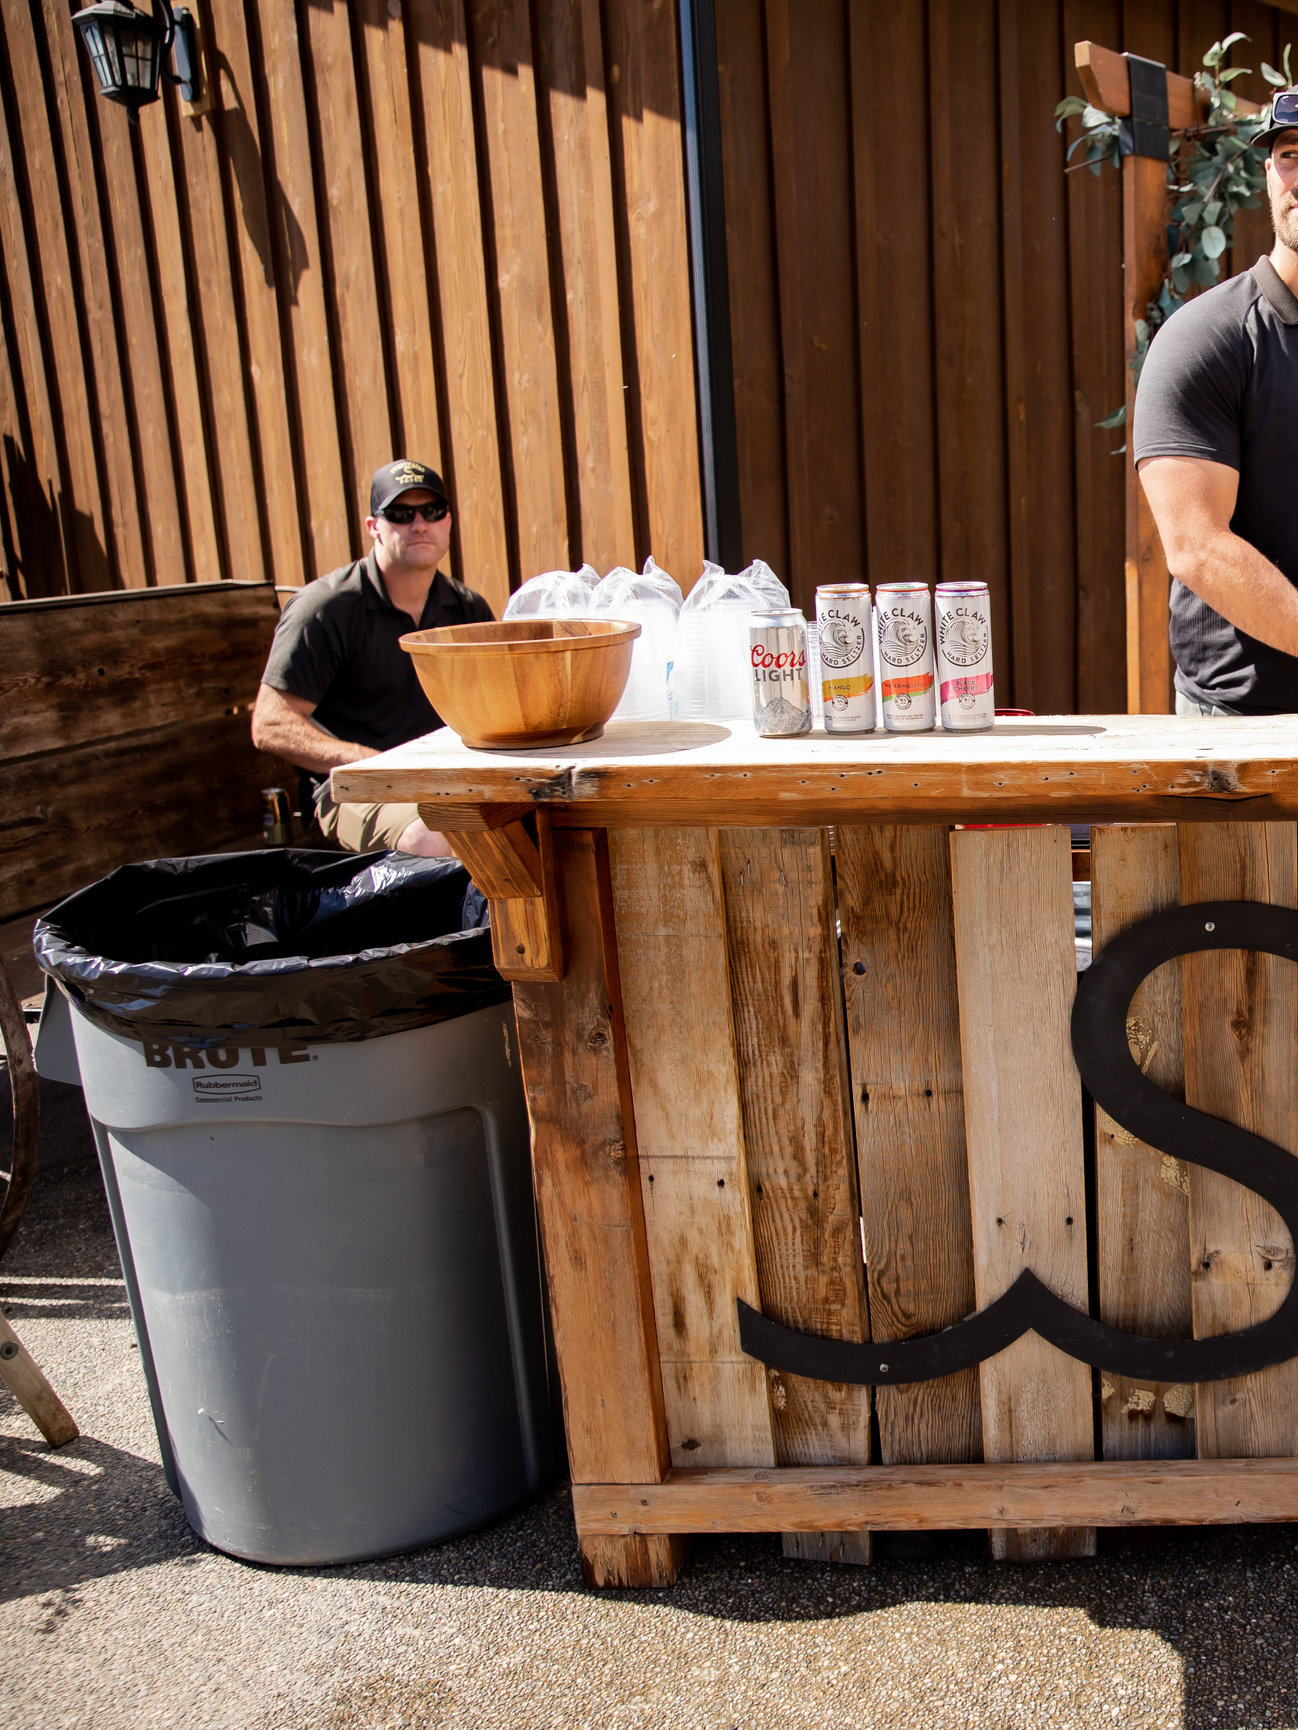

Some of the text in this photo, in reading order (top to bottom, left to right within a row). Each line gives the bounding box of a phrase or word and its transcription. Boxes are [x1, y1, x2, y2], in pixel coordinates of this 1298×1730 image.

[828, 609, 861, 627] CLAW
[878, 607, 924, 645] WHITE CLAW
[939, 607, 986, 645] WHITE CLAW
[750, 644, 806, 669] Coors
[822, 635, 862, 665] HARD SELTZER
[883, 633, 925, 664] HARD SELTZER
[946, 632, 987, 664] HARD SELTZER
[755, 668, 802, 682] LIGHT
[195, 1080, 258, 1089] Rubbermaid
